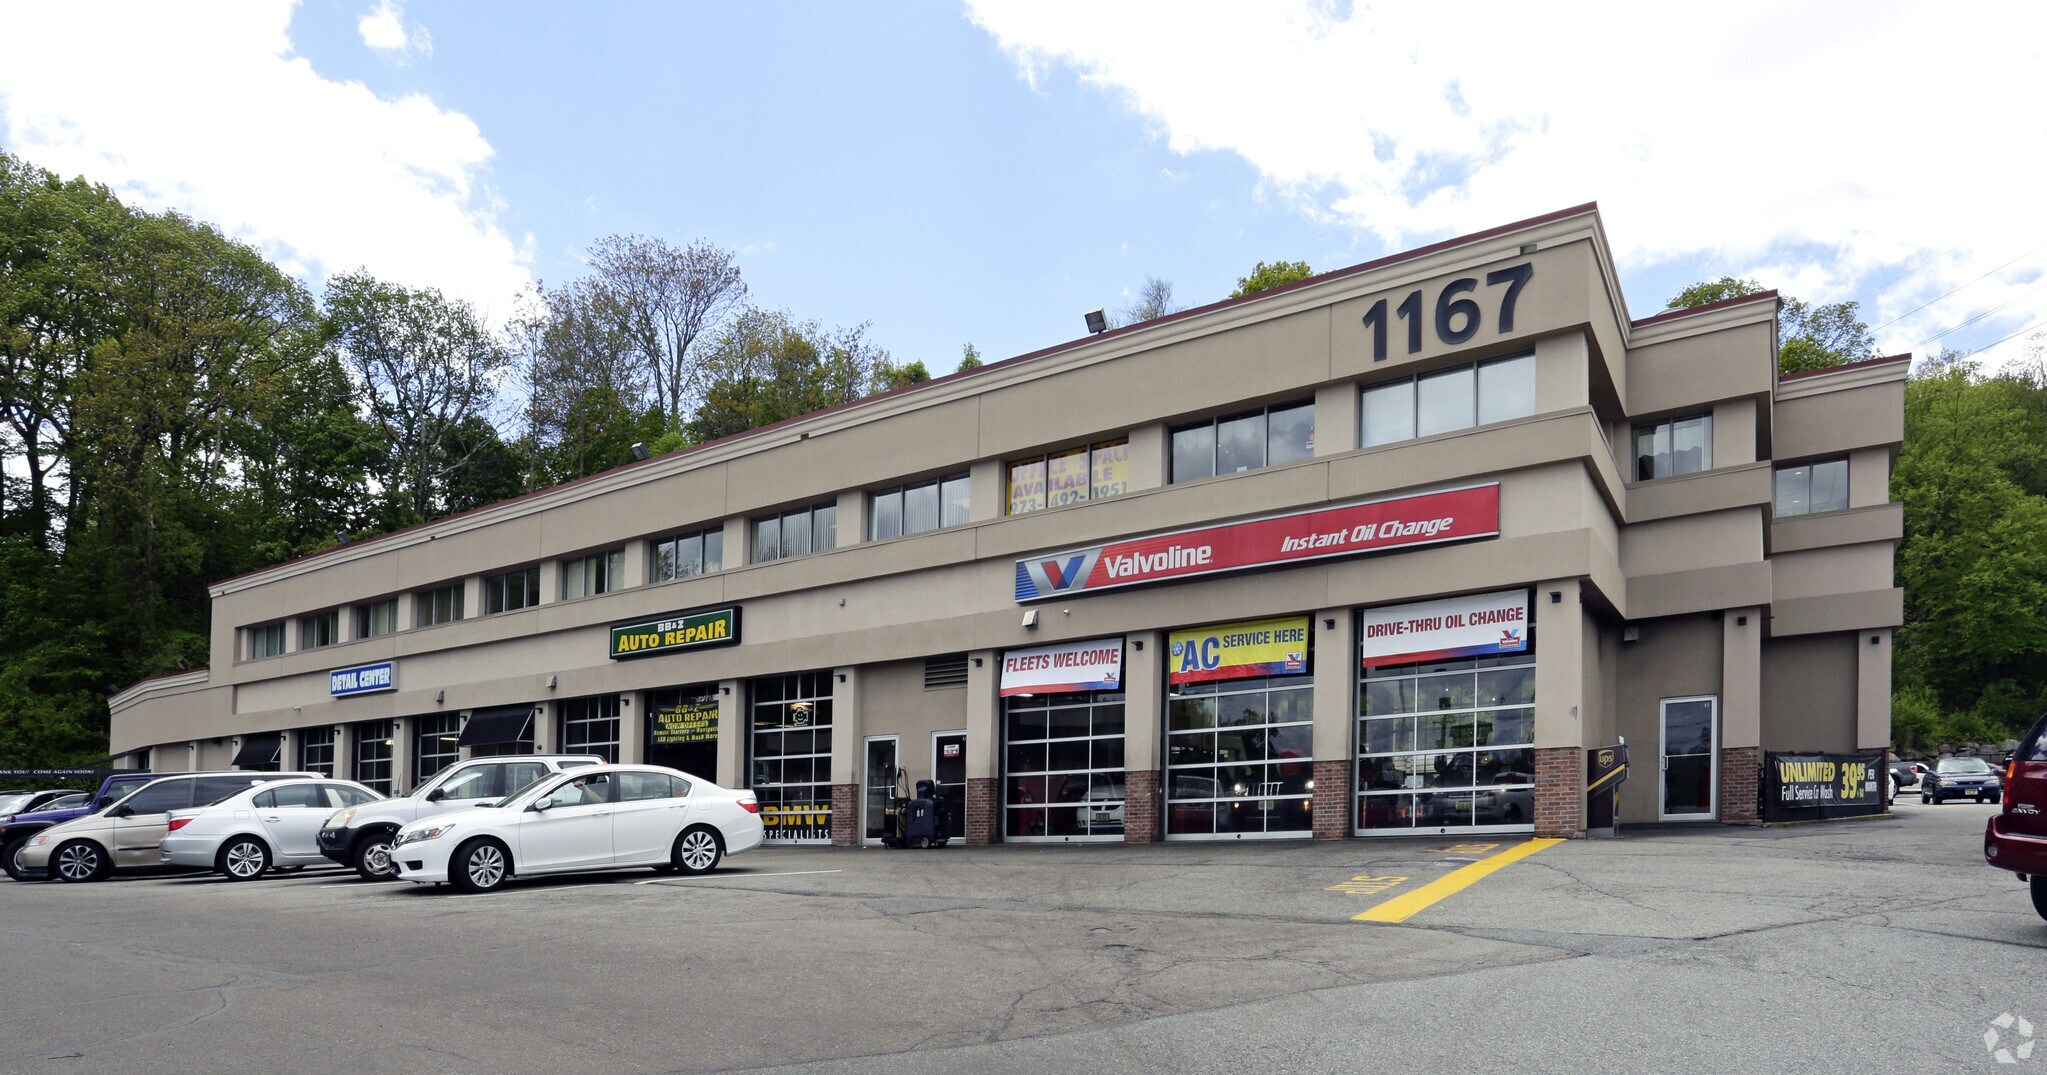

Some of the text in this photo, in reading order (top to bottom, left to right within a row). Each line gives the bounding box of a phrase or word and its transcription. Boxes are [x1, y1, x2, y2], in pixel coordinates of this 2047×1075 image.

[1362, 262, 1534, 362] 1167
[1013, 467, 1113, 499] AVAILABLE
[1050, 490, 1086, 507] 492-
[1093, 481, 1128, 499] 1951
[1104, 516, 1454, 578] Valvoline Instant Oil Change
[657, 619, 684, 632] BB&Z
[1367, 606, 1524, 638] DRIVE-THRU OIL CHANGE
[617, 619, 726, 652] AUTO REPAIR
[1005, 648, 1119, 673] FLEETS WELCOME
[1179, 628, 1305, 673] AC SERVICE HERE
[331, 667, 390, 691] DETAIL CENTER
[658, 710, 718, 723] AUTO REPAIR
[1600, 755, 1613, 766] ups
[1780, 762, 1835, 783] UNLIMITED
[1782, 785, 1794, 801] Full
[1795, 785, 1813, 800] Service
[1820, 783, 1834, 799] Wash
[763, 804, 829, 826] BMW
